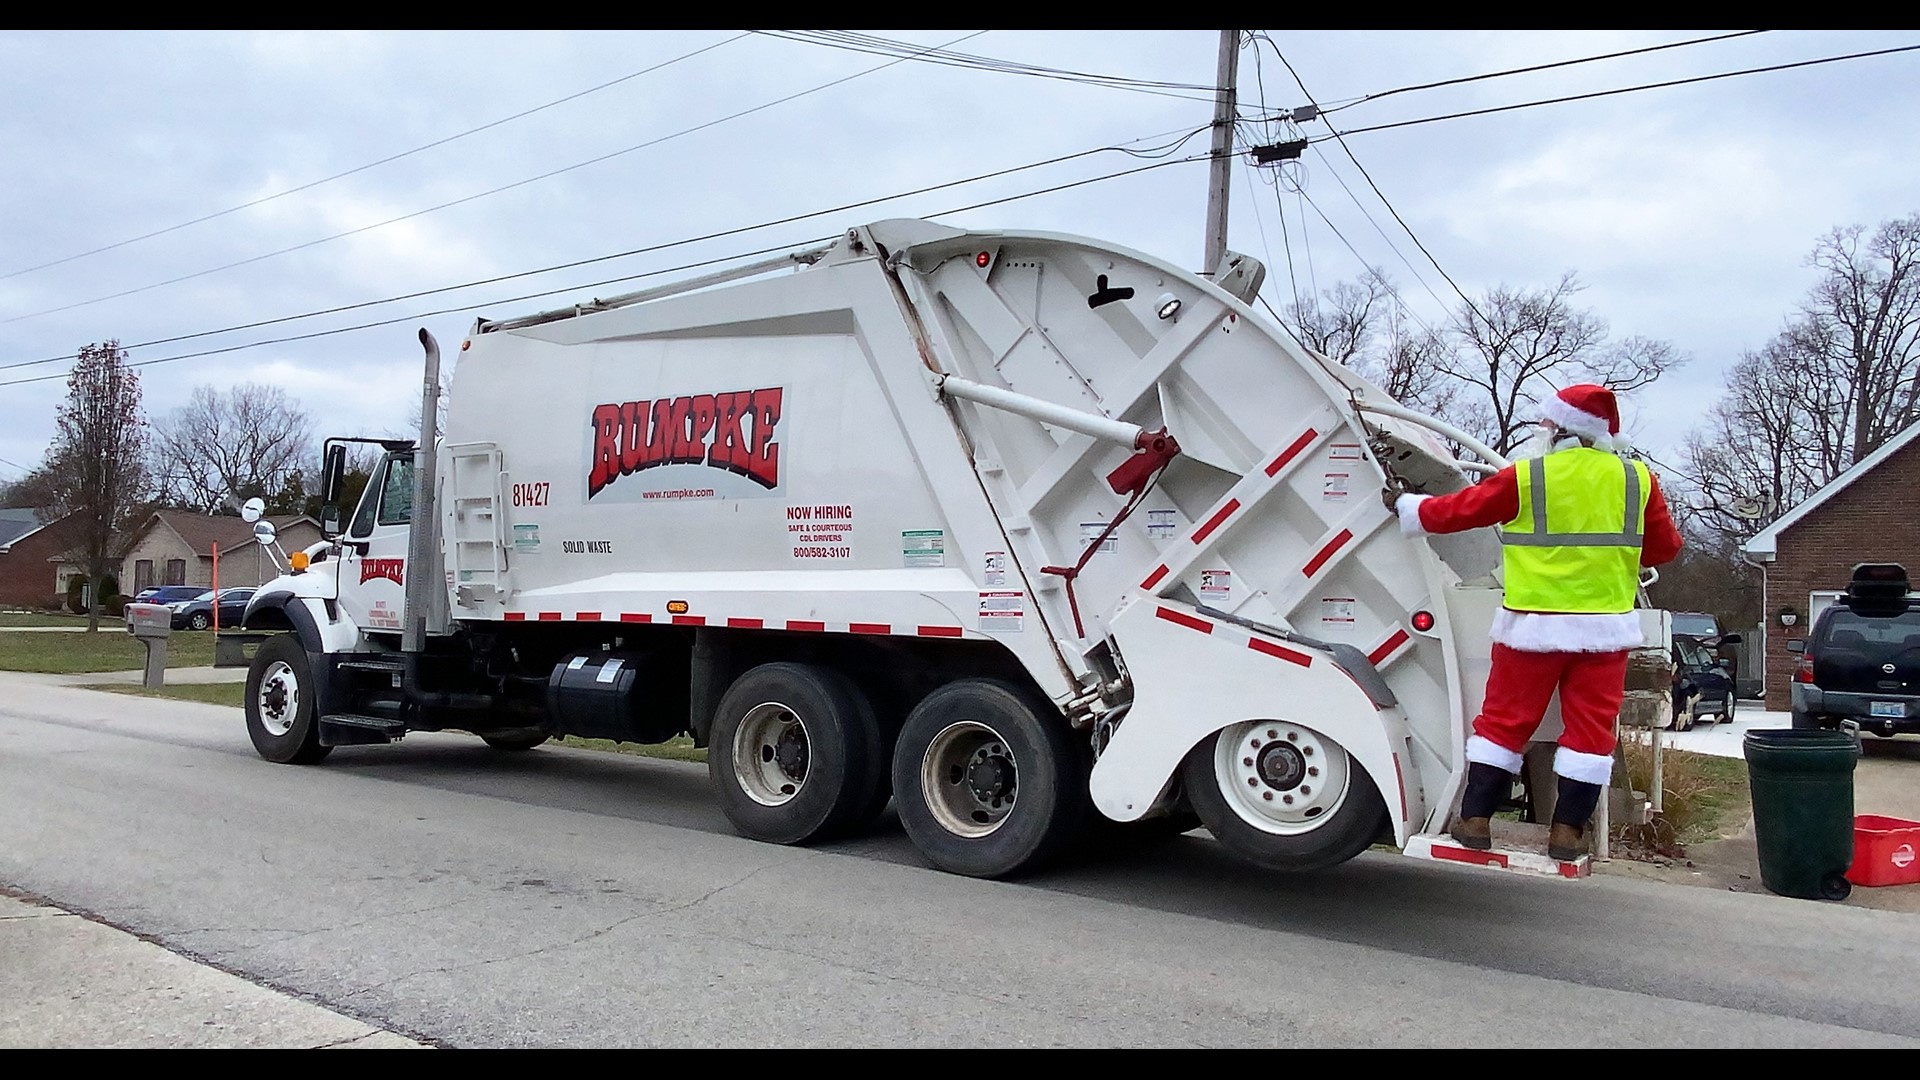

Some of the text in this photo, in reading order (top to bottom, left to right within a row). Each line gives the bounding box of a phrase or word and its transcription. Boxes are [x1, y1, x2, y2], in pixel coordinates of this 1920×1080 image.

[588, 387, 783, 501] RUMPKE
[513, 482, 550, 507] 81427
[642, 488, 715, 500] www.rumpke.com
[787, 505, 852, 520] NOW HIRING
[788, 523, 853, 532] SAFE & COURTEOUS
[799, 534, 843, 542] CDL DRIVERS
[562, 541, 613, 554] SOLID WASTE
[793, 547, 851, 558] 800/582-3107
[360, 559, 404, 586] RUMPKE
